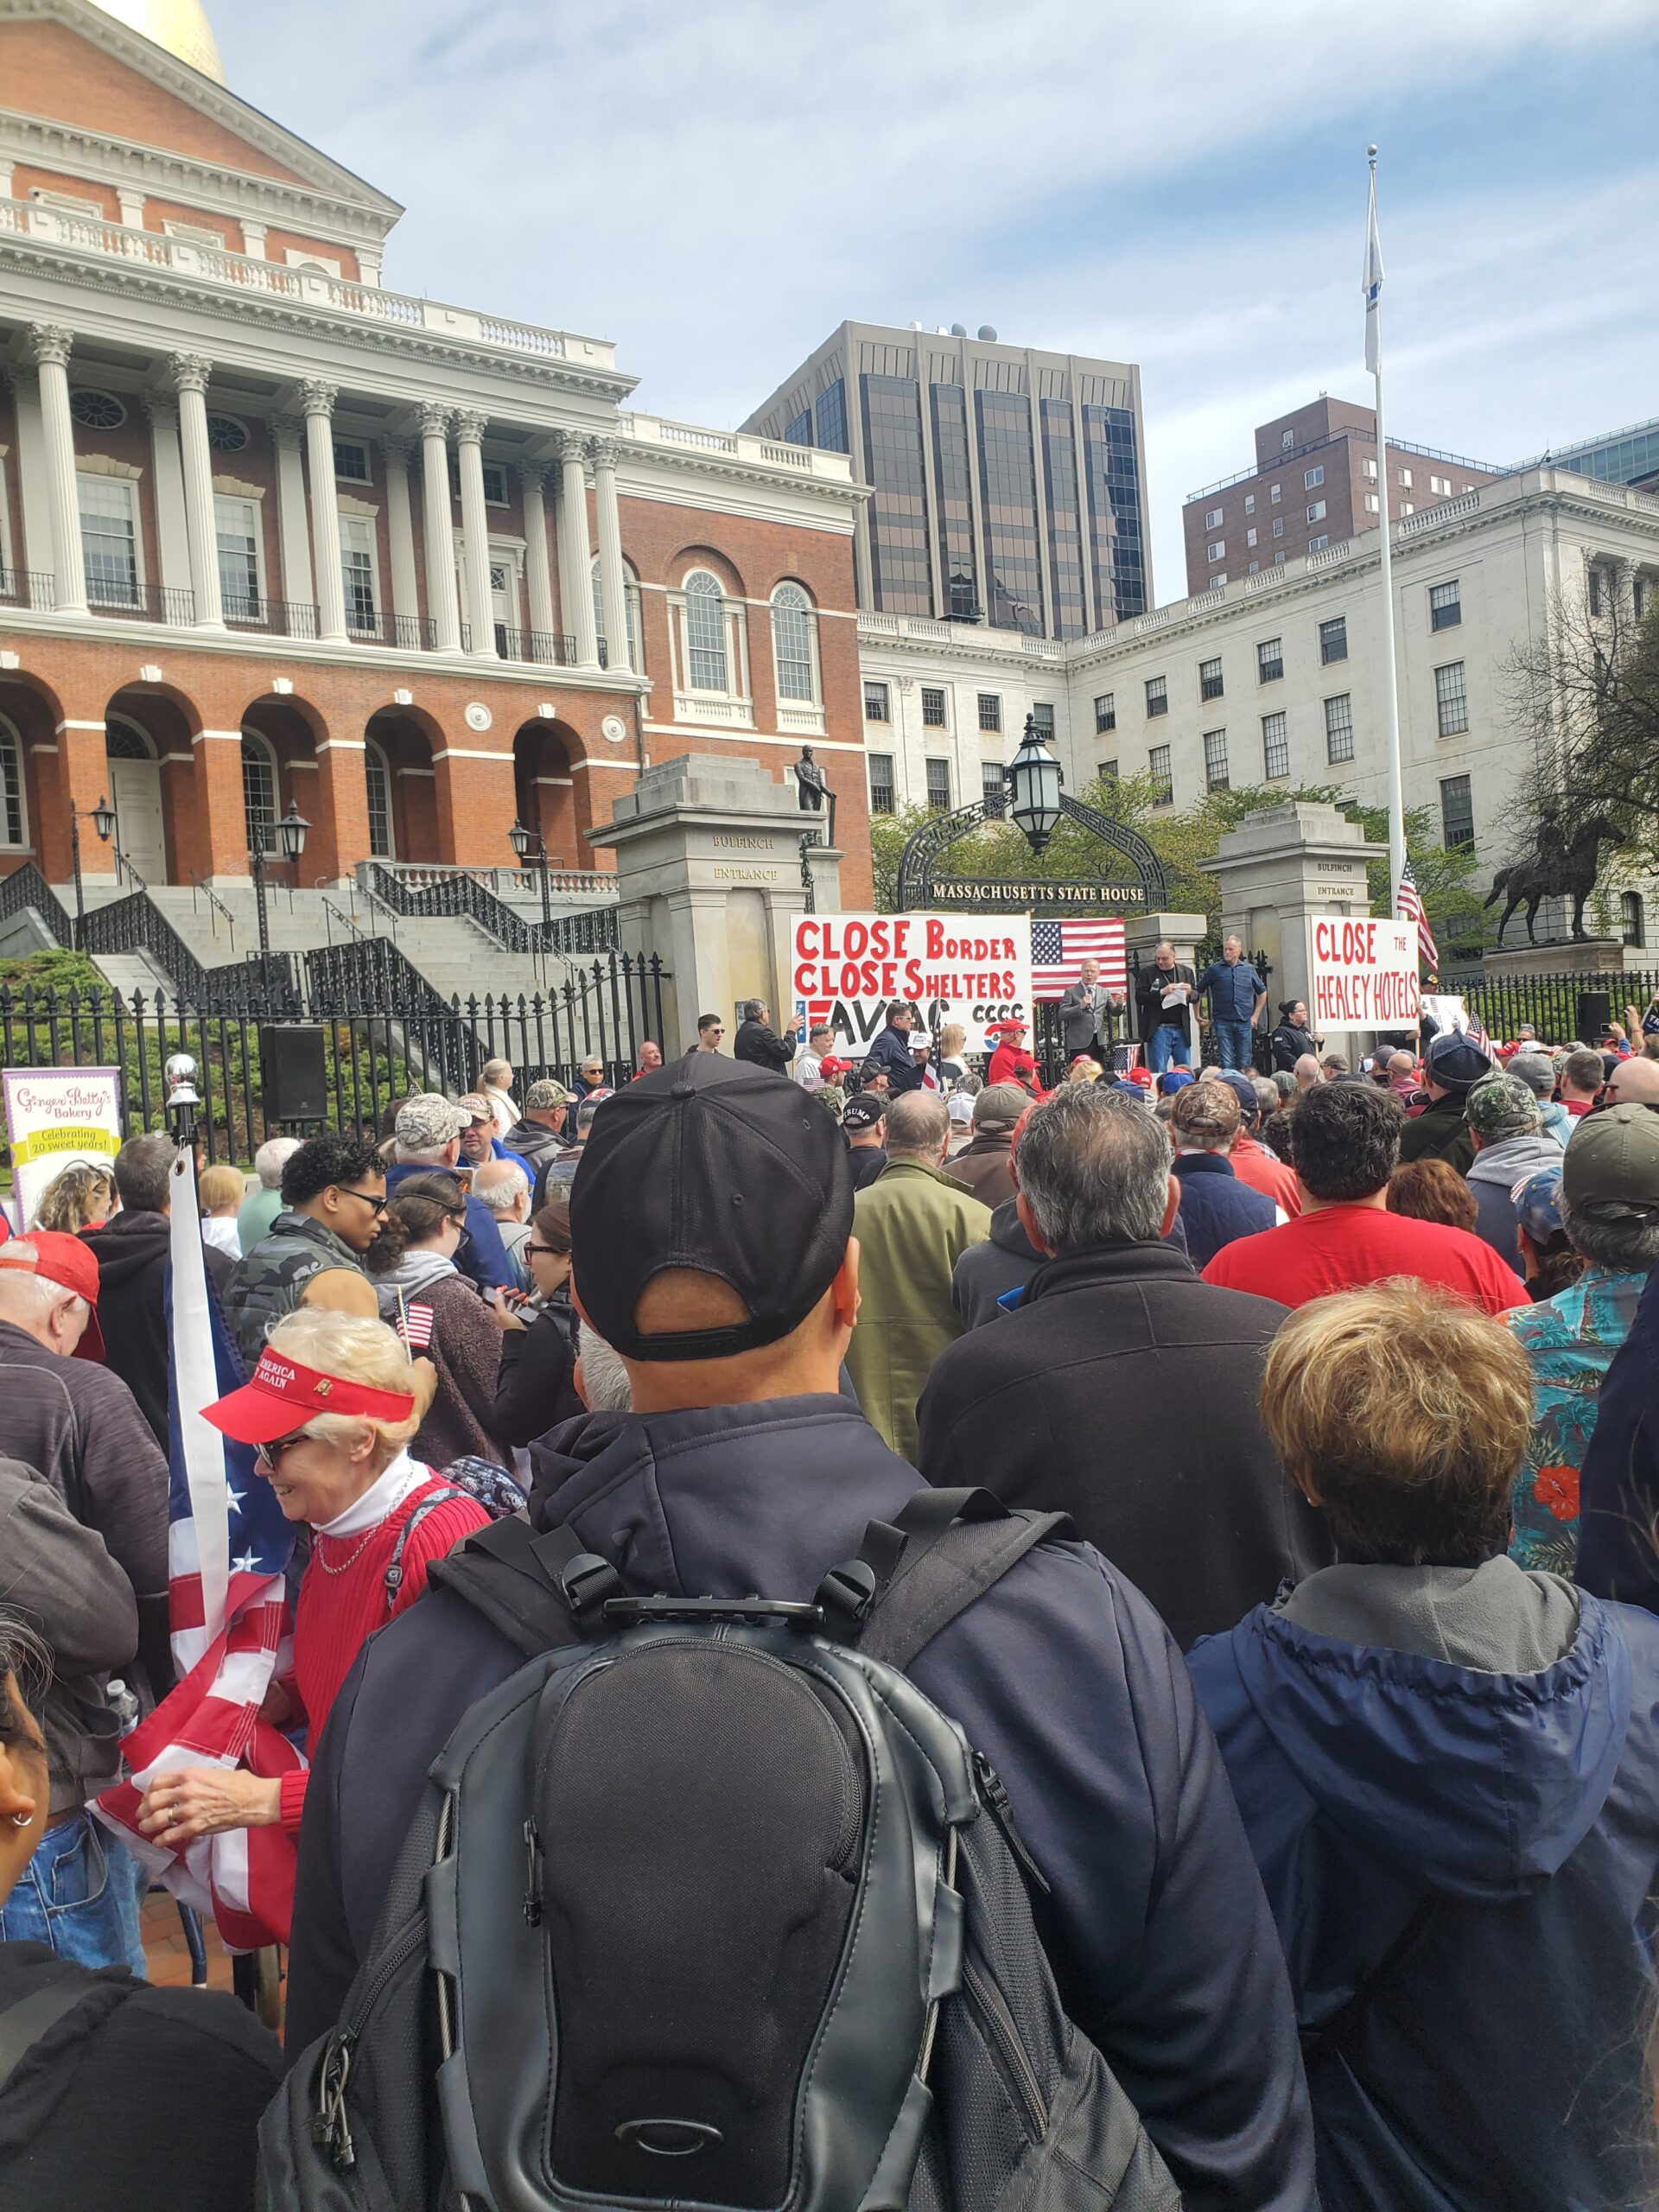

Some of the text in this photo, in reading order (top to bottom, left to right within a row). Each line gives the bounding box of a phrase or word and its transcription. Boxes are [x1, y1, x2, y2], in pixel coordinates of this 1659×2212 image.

[713, 836, 774, 849] BULFINCH
[714, 868, 778, 880] ENTRANCE
[1317, 863, 1352, 873] BULFINCH
[932, 884, 1145, 901] MASSACHUSETTS STATE HOUSE
[1317, 887, 1355, 896] ENTRANCE
[796, 918, 1016, 961] CLOSE BORDER
[1316, 921, 1407, 965] CLOSE THE
[794, 958, 1016, 1001] CLOSE SHELTERS
[1316, 970, 1419, 1021] HEALEY HOTELS
[973, 1003, 1025, 1023] CCCC
[17, 1086, 111, 1116] Ginger Betty's
[54, 1107, 92, 1120] Bakery
[843, 1108, 870, 1121] TRUMP
[41, 1128, 96, 1141] Celebrating
[32, 1139, 107, 1154] 20 sweet years!
[258, 1370, 288, 1389] AGAIN
